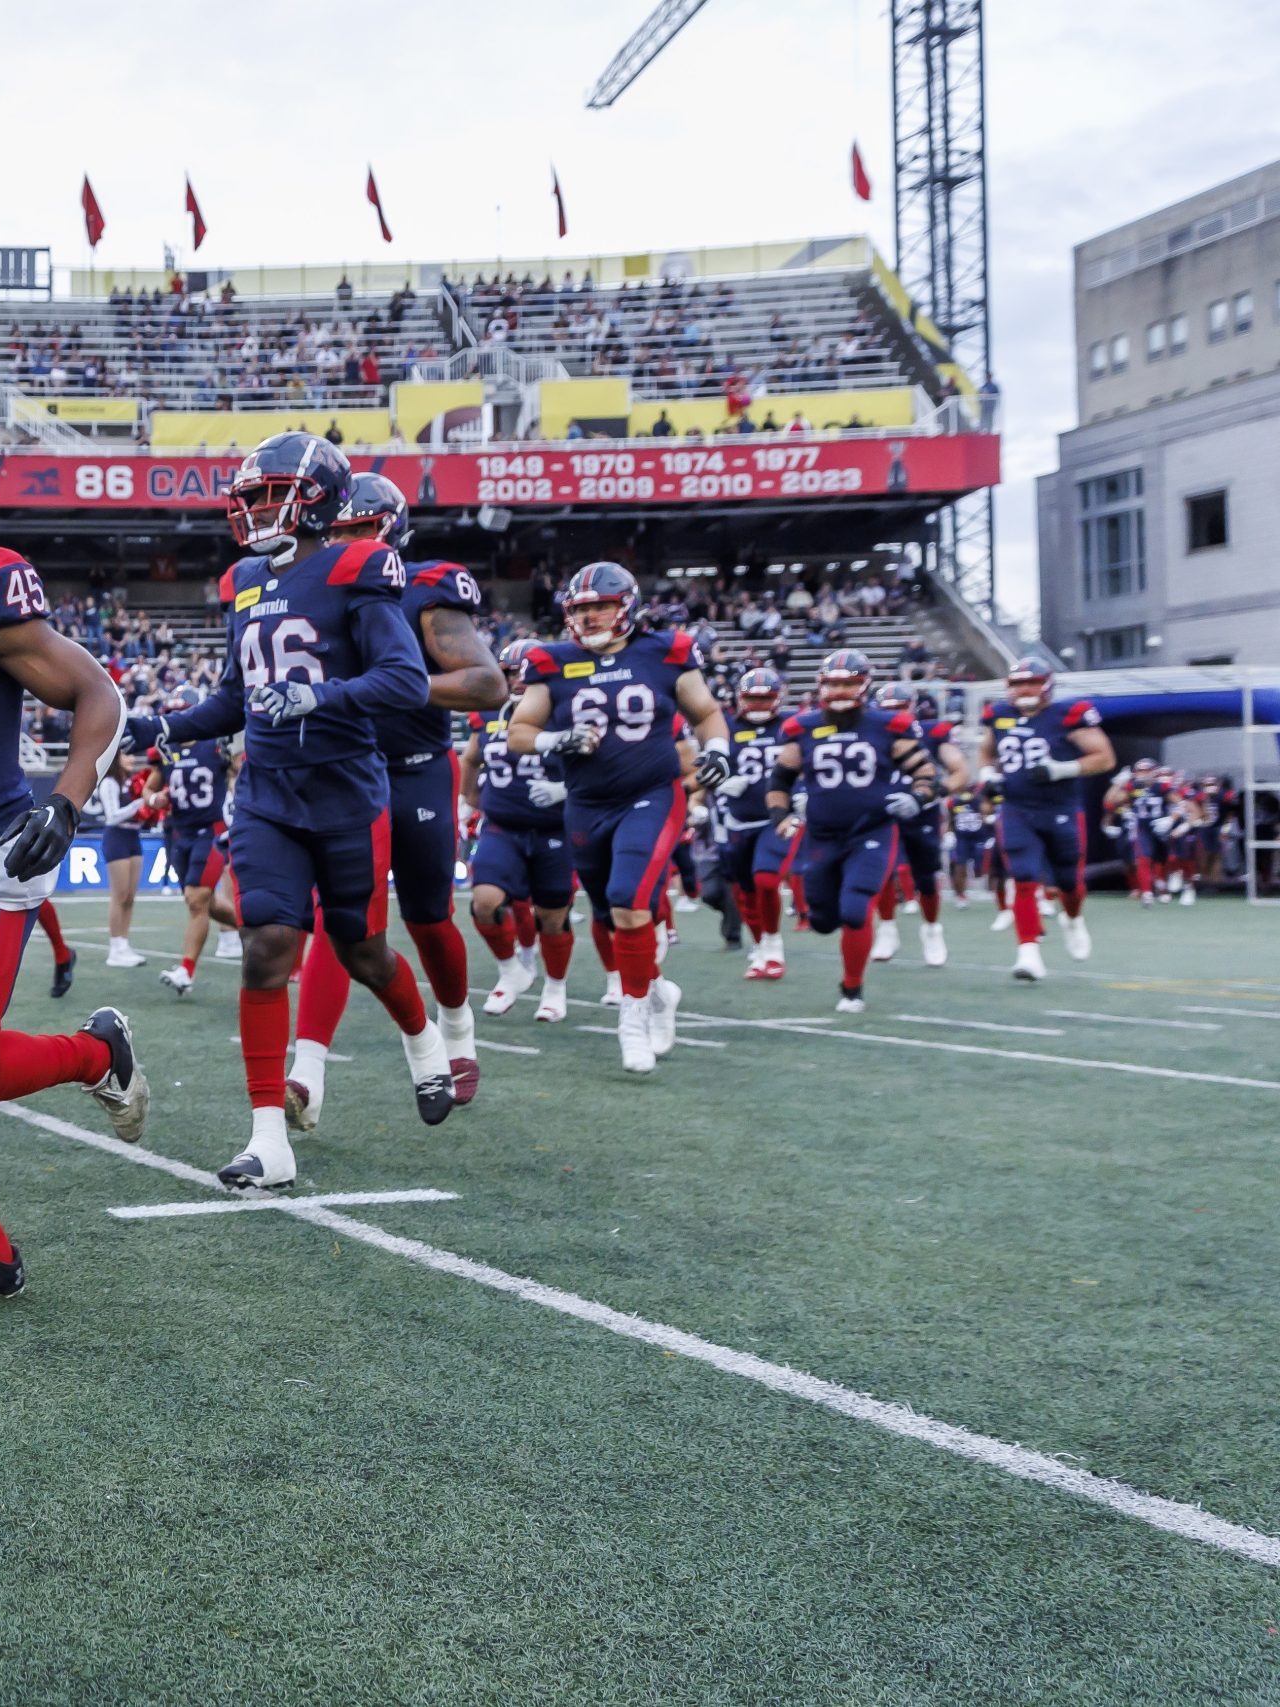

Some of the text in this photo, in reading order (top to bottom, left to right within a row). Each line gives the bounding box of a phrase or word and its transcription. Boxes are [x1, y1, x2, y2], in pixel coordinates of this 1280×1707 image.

[75, 464, 134, 500] 86
[477, 456, 544, 478] 1949
[570, 453, 636, 477] 1970
[661, 451, 726, 475] 1974
[752, 446, 820, 471] 1977
[477, 478, 553, 501] 2002
[578, 475, 655, 499] 2009
[681, 473, 753, 498] 2010
[780, 468, 862, 493] 2023
[5, 567, 46, 616] 45
[382, 550, 408, 589] 46
[239, 616, 325, 713] 46
[571, 682, 656, 744] 69
[169, 765, 215, 811] 43
[812, 740, 878, 790] 53
